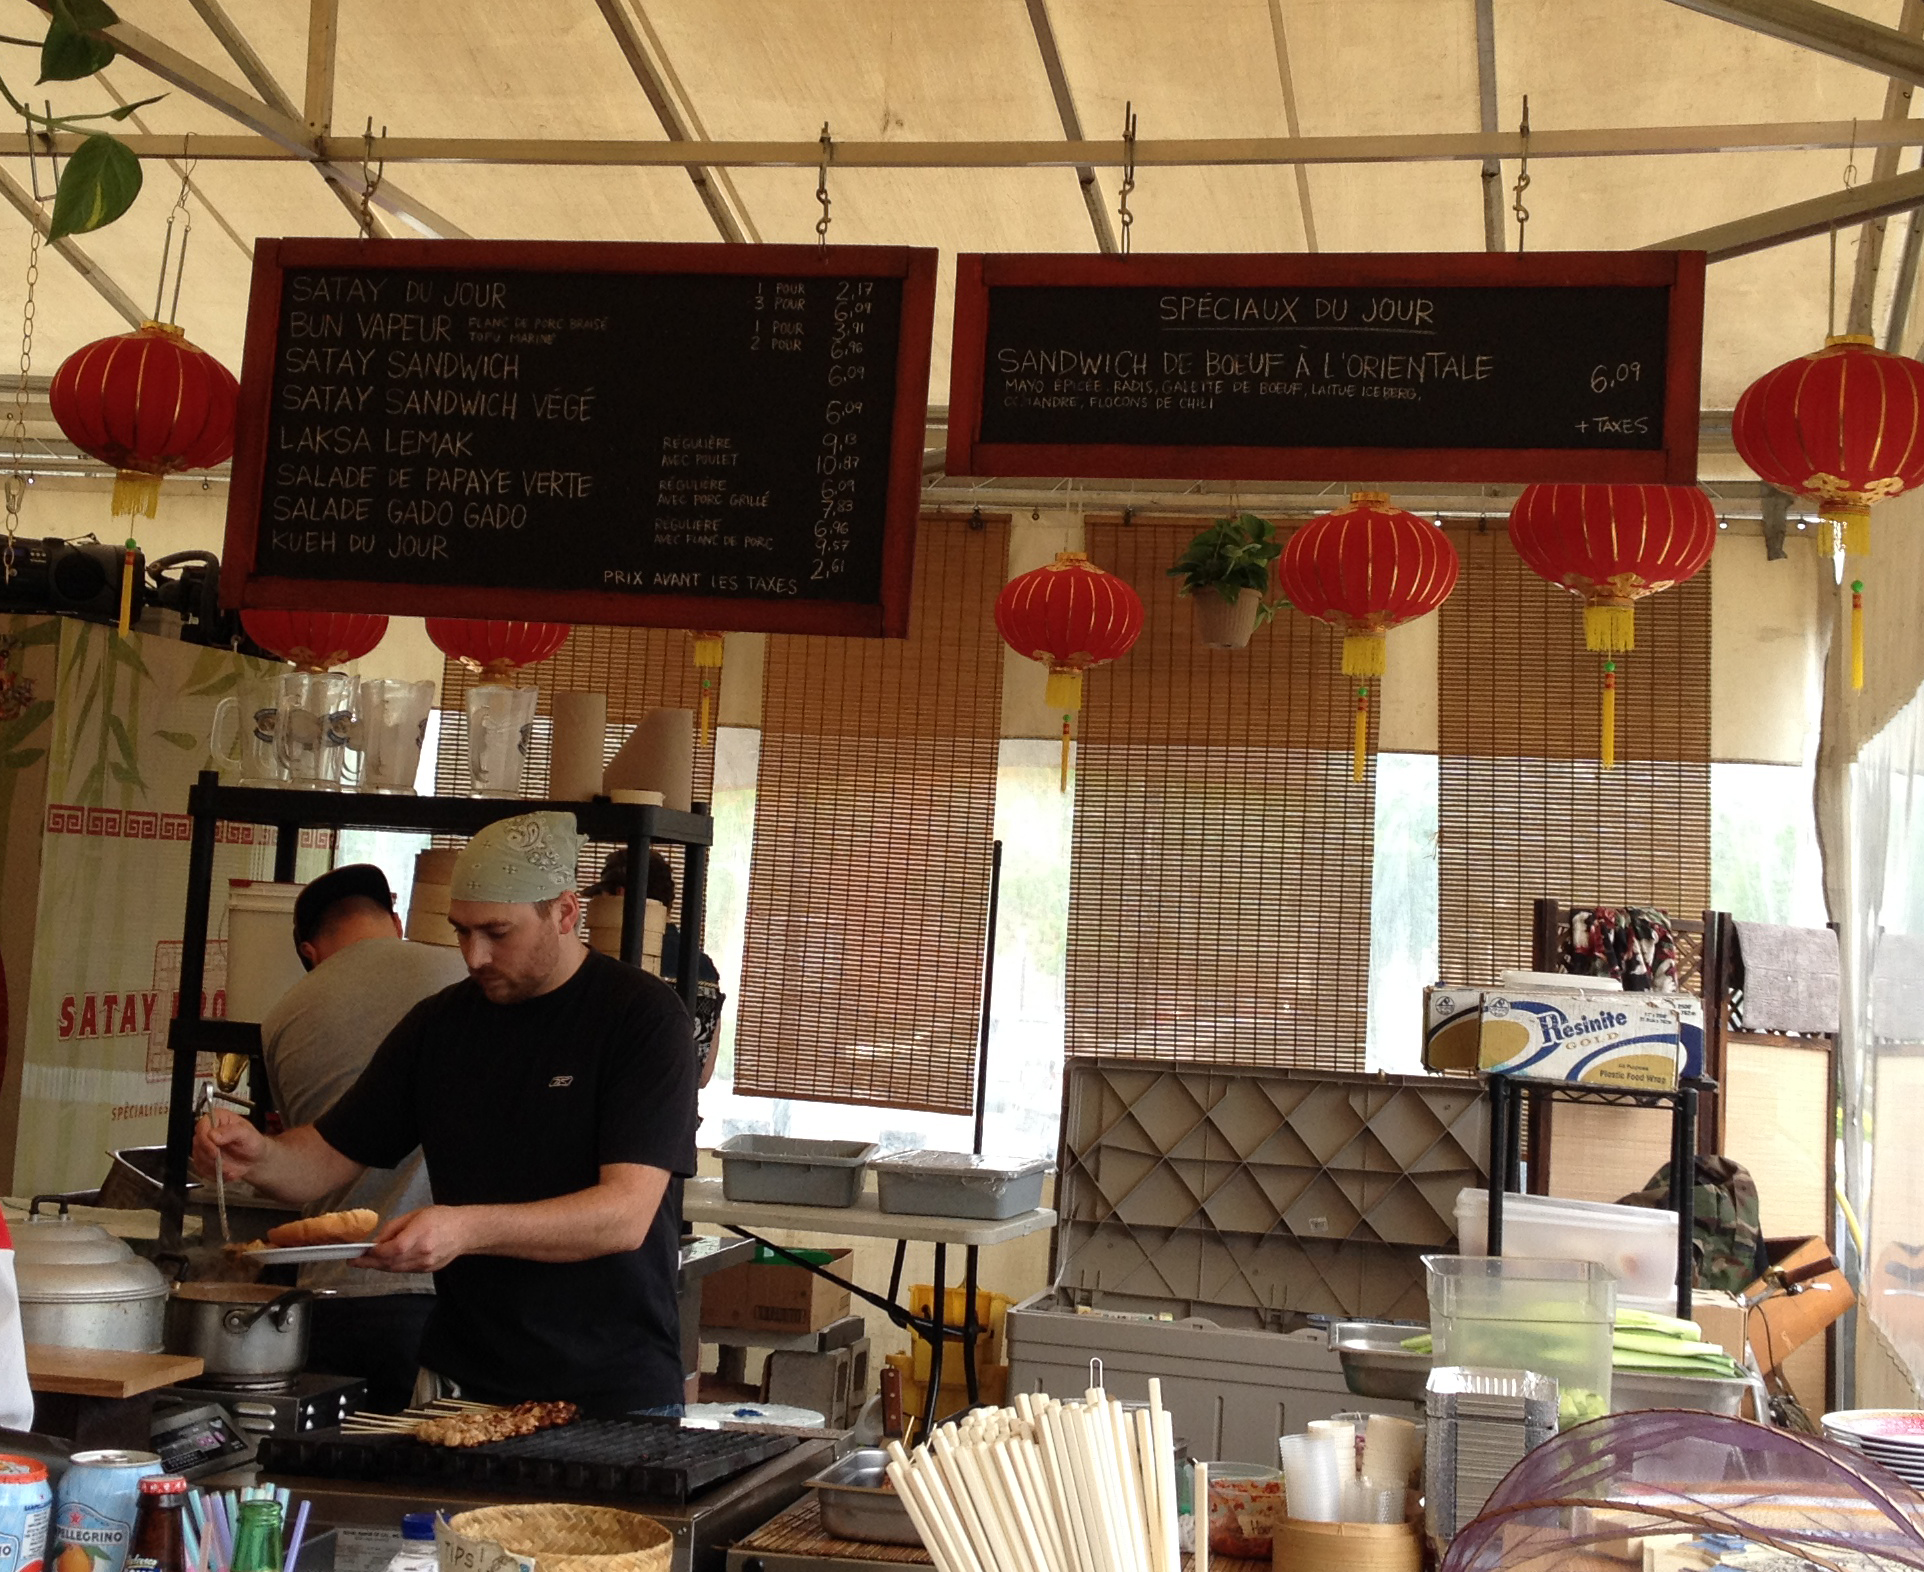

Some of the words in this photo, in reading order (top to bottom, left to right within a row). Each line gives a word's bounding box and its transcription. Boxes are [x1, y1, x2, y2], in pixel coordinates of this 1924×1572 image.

[292, 276, 388, 302] SATAY
[406, 281, 431, 301] DU
[445, 282, 506, 308] JOUR
[758, 281, 762, 294] 1
[776, 282, 805, 294] POUR
[836, 281, 874, 301] 2,17
[754, 296, 764, 310] 3
[774, 297, 806, 311] POUR
[834, 301, 872, 321] 6,09
[1160, 292, 1300, 324] SPÉCIAUX
[1315, 298, 1348, 321] DU
[1362, 298, 1434, 326] JOUR
[290, 312, 343, 338] BUN
[357, 313, 451, 342] VAPEUR
[515, 317, 527, 328] DE
[534, 318, 564, 330] PORC
[756, 320, 759, 332] 1
[772, 320, 804, 335] POUR
[832, 322, 864, 341] 3,91
[469, 332, 500, 342] TOFU
[751, 336, 760, 350] 2
[772, 338, 802, 350] POUR
[831, 340, 863, 359] 6,96
[286, 348, 376, 377] SATAY
[387, 351, 519, 381] SANDWICH
[997, 348, 1148, 378] SANDWICH
[1164, 351, 1193, 375] DE
[1296, 344, 1310, 378] À
[1324, 351, 1494, 383] L'ORIENTALE
[828, 364, 865, 387] 6,09
[1590, 362, 1641, 394] 6,09
[1005, 378, 1045, 394] MAYO
[1114, 380, 1158, 395] RADIS,
[1233, 380, 1250, 393] DE
[1311, 382, 1356, 398] LAITUE
[282, 385, 374, 412] SATAY
[385, 388, 518, 420] SANDWICH
[532, 387, 597, 421] VÉGÉ
[826, 400, 863, 424] 6,09
[1090, 396, 1148, 408] FLOCONS
[1156, 397, 1173, 410] DE
[1180, 397, 1214, 410] CHILI
[280, 426, 372, 454] LAKSA
[385, 429, 474, 458] LEMAK
[822, 433, 857, 455] 9,13
[662, 454, 690, 468] AVEC
[696, 453, 740, 467] POULET
[816, 455, 860, 475] 10,87
[276, 464, 378, 488] SALADE
[388, 468, 414, 488] DE
[426, 468, 513, 496] PAPAYE
[522, 470, 594, 498] VERTE
[822, 478, 855, 500] 6,09
[656, 494, 688, 506] AVEC
[694, 494, 722, 506] PORC
[730, 490, 770, 508] GRILLÉ
[821, 500, 854, 519] 7,83
[273, 496, 374, 522] SALADE
[387, 500, 454, 527] GADO
[463, 502, 528, 529] GADO
[814, 520, 848, 538] 6,96
[272, 532, 336, 553] KUEH
[350, 534, 376, 552] DU
[388, 534, 449, 560] JOUR
[654, 534, 681, 545] AVEC
[723, 536, 736, 546] DE
[744, 535, 774, 551] PORC
[816, 538, 850, 556] 9,57
[810, 558, 845, 580] 2,61
[604, 570, 643, 586] PRIX
[653, 572, 700, 587] AVANT
[711, 575, 738, 591] LES
[746, 576, 798, 595] TAXES
[58, 992, 158, 1039] SATAY
[1537, 1010, 1628, 1045] Resinite
[1566, 1032, 1619, 1050] GOLD
[1600, 1070, 1625, 1080] Plastic
[1627, 1072, 1644, 1081] Food
[1647, 1075, 1667, 1084] Wrap
